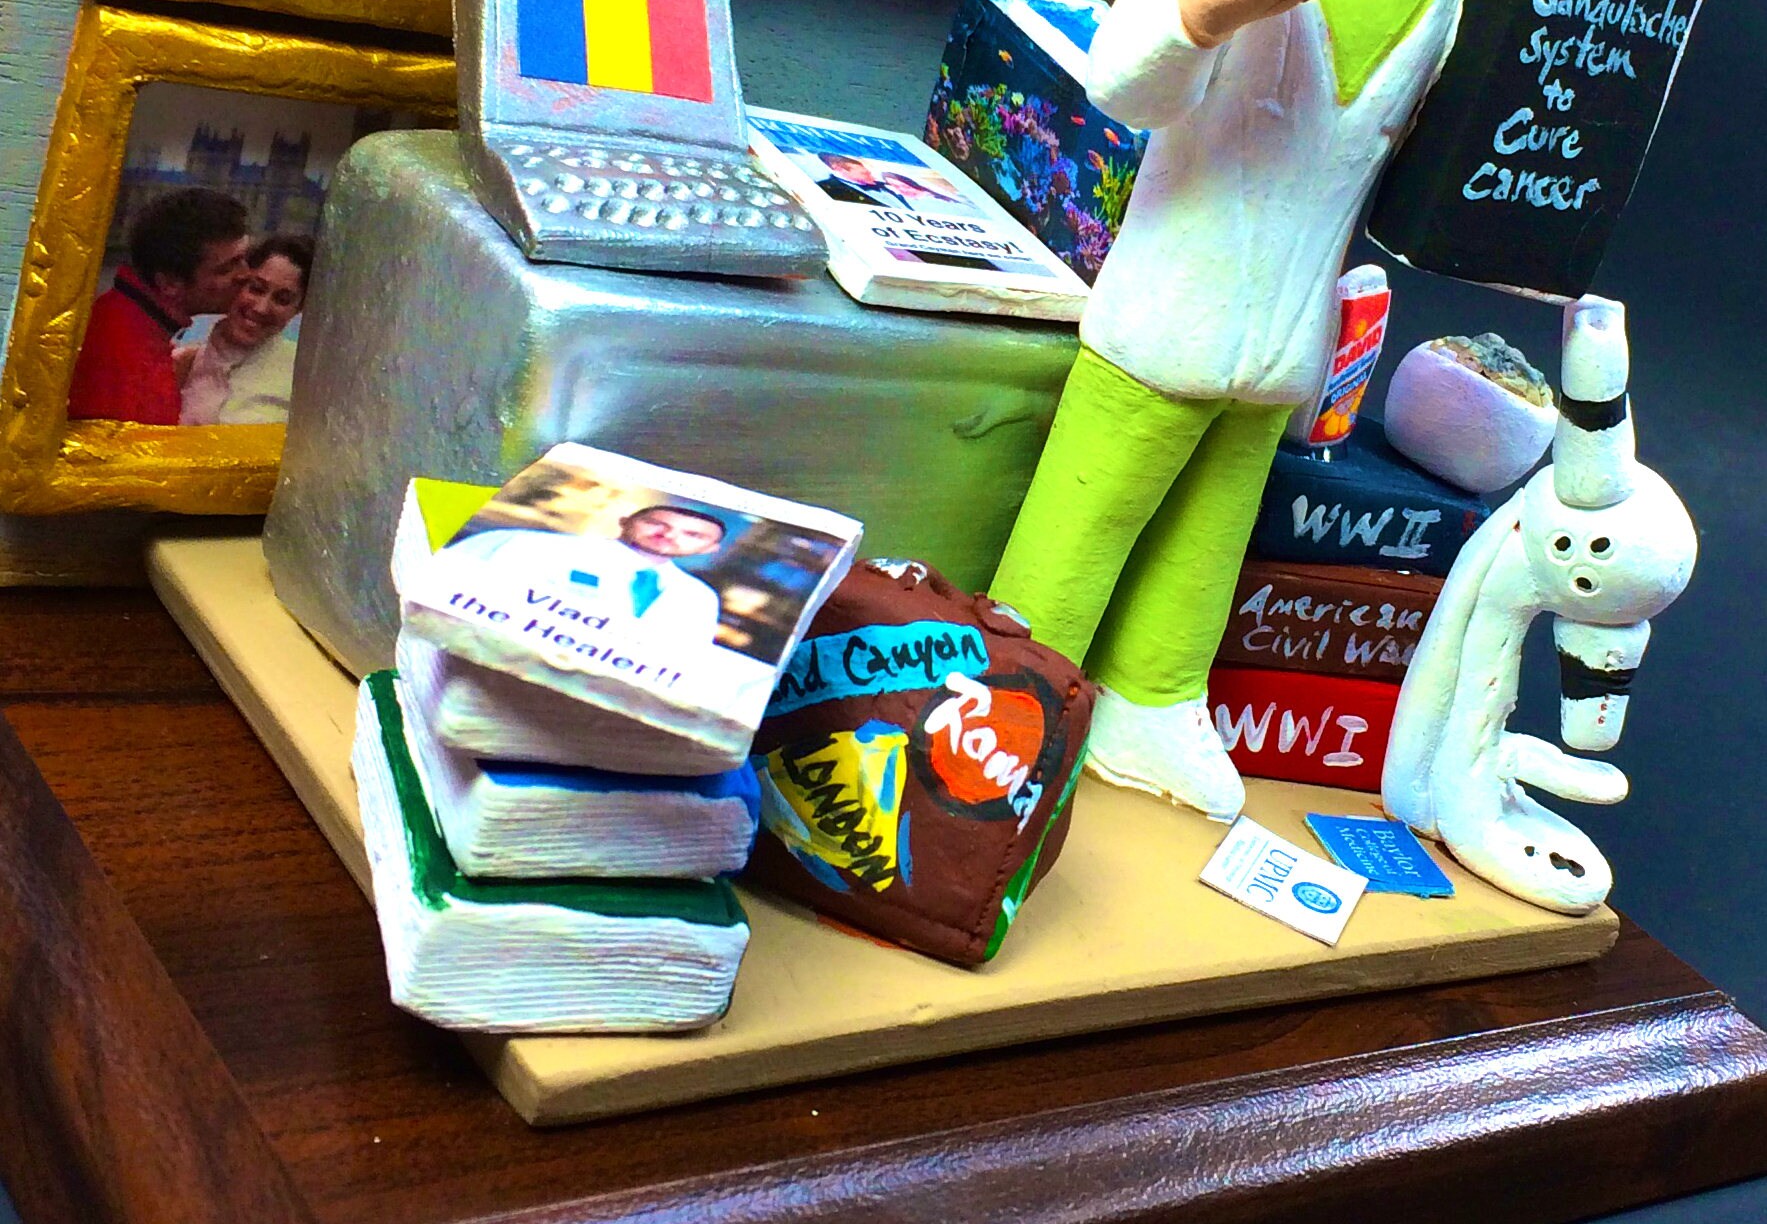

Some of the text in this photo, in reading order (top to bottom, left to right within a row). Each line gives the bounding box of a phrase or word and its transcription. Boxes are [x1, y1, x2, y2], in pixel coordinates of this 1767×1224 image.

[1519, 24, 1637, 85] System
[1543, 78, 1576, 111] to
[1493, 107, 1584, 159] Cure
[1462, 161, 1602, 211] Cancer
[869, 209, 986, 234] 10 Years
[871, 226, 1024, 255] of Ecstasy!
[1332, 325, 1383, 377] DAVID
[1330, 371, 1368, 404] ORIGINAL
[526, 587, 610, 631] Vlad
[1238, 584, 1423, 630] American
[449, 591, 683, 689] the Healer!!
[1242, 626, 1331, 660] Civil
[1246, 848, 1298, 903] UPMC
[1372, 828, 1422, 878] Baylor
